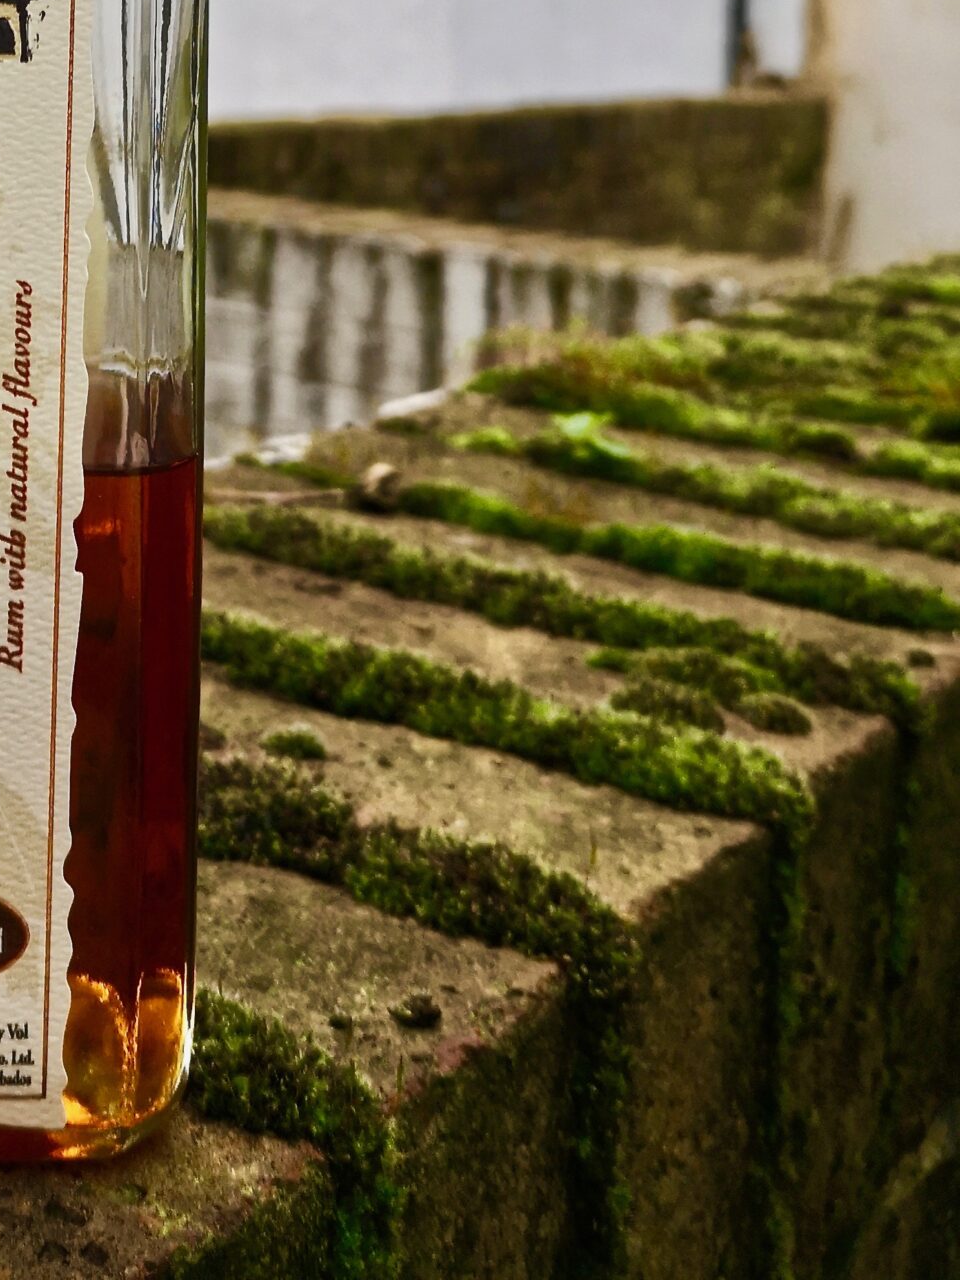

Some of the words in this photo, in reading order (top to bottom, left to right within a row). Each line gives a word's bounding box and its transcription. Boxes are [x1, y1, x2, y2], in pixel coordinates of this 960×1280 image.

[2, 280, 37, 406] flavours
[1, 404, 28, 523] natural
[7, 1021, 28, 1039] Vol
[11, 1049, 34, 1065] Ltd.
